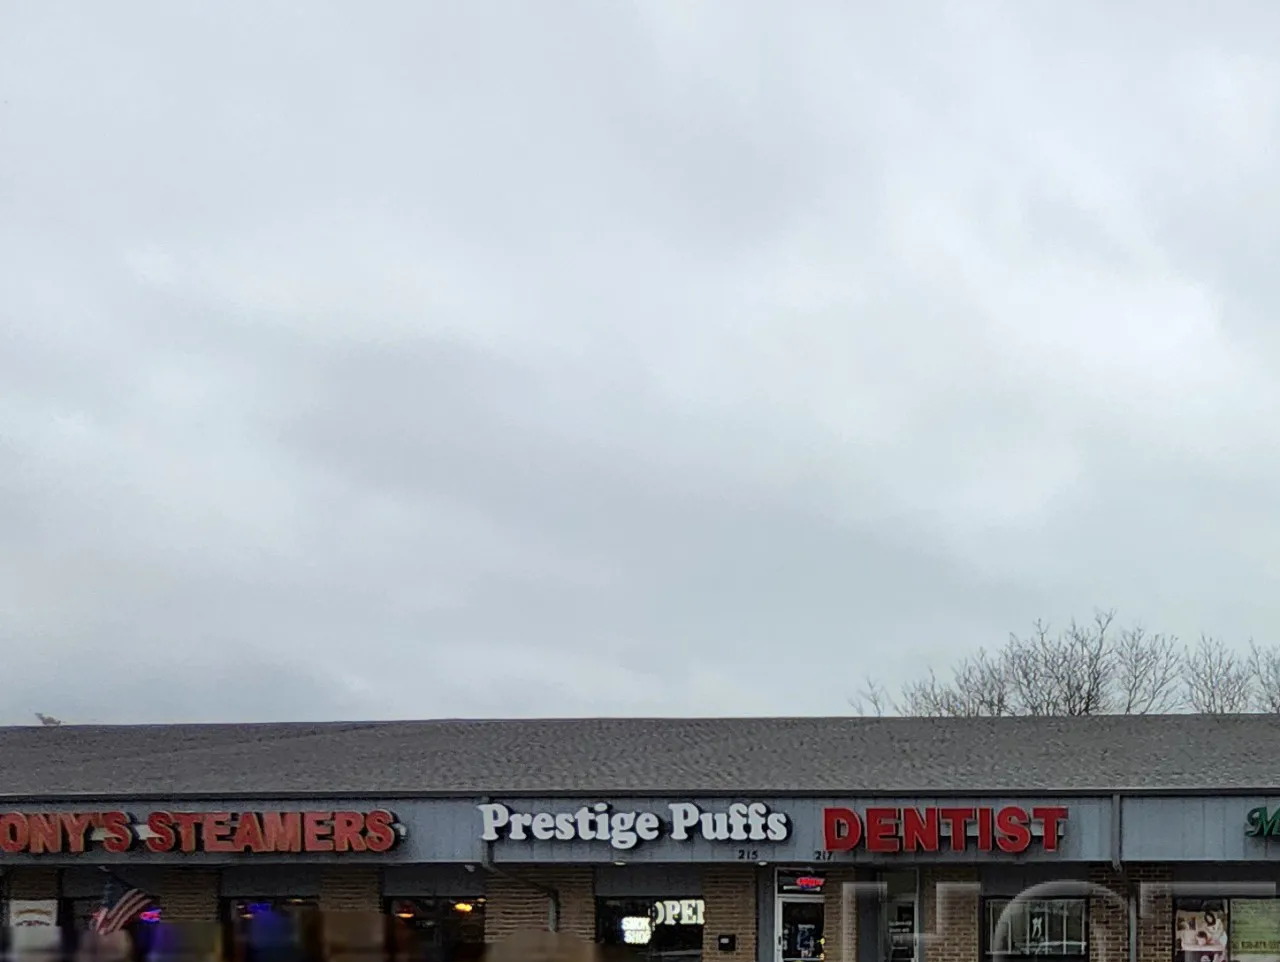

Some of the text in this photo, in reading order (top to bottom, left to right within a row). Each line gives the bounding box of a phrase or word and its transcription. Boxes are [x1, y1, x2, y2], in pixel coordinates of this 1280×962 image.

[146, 810, 396, 853] STEAMERS
[479, 803, 789, 850] Prestige Puffs
[823, 806, 1069, 853] DENTIST
[738, 849, 758, 860] 215
[814, 850, 834, 861] 217
